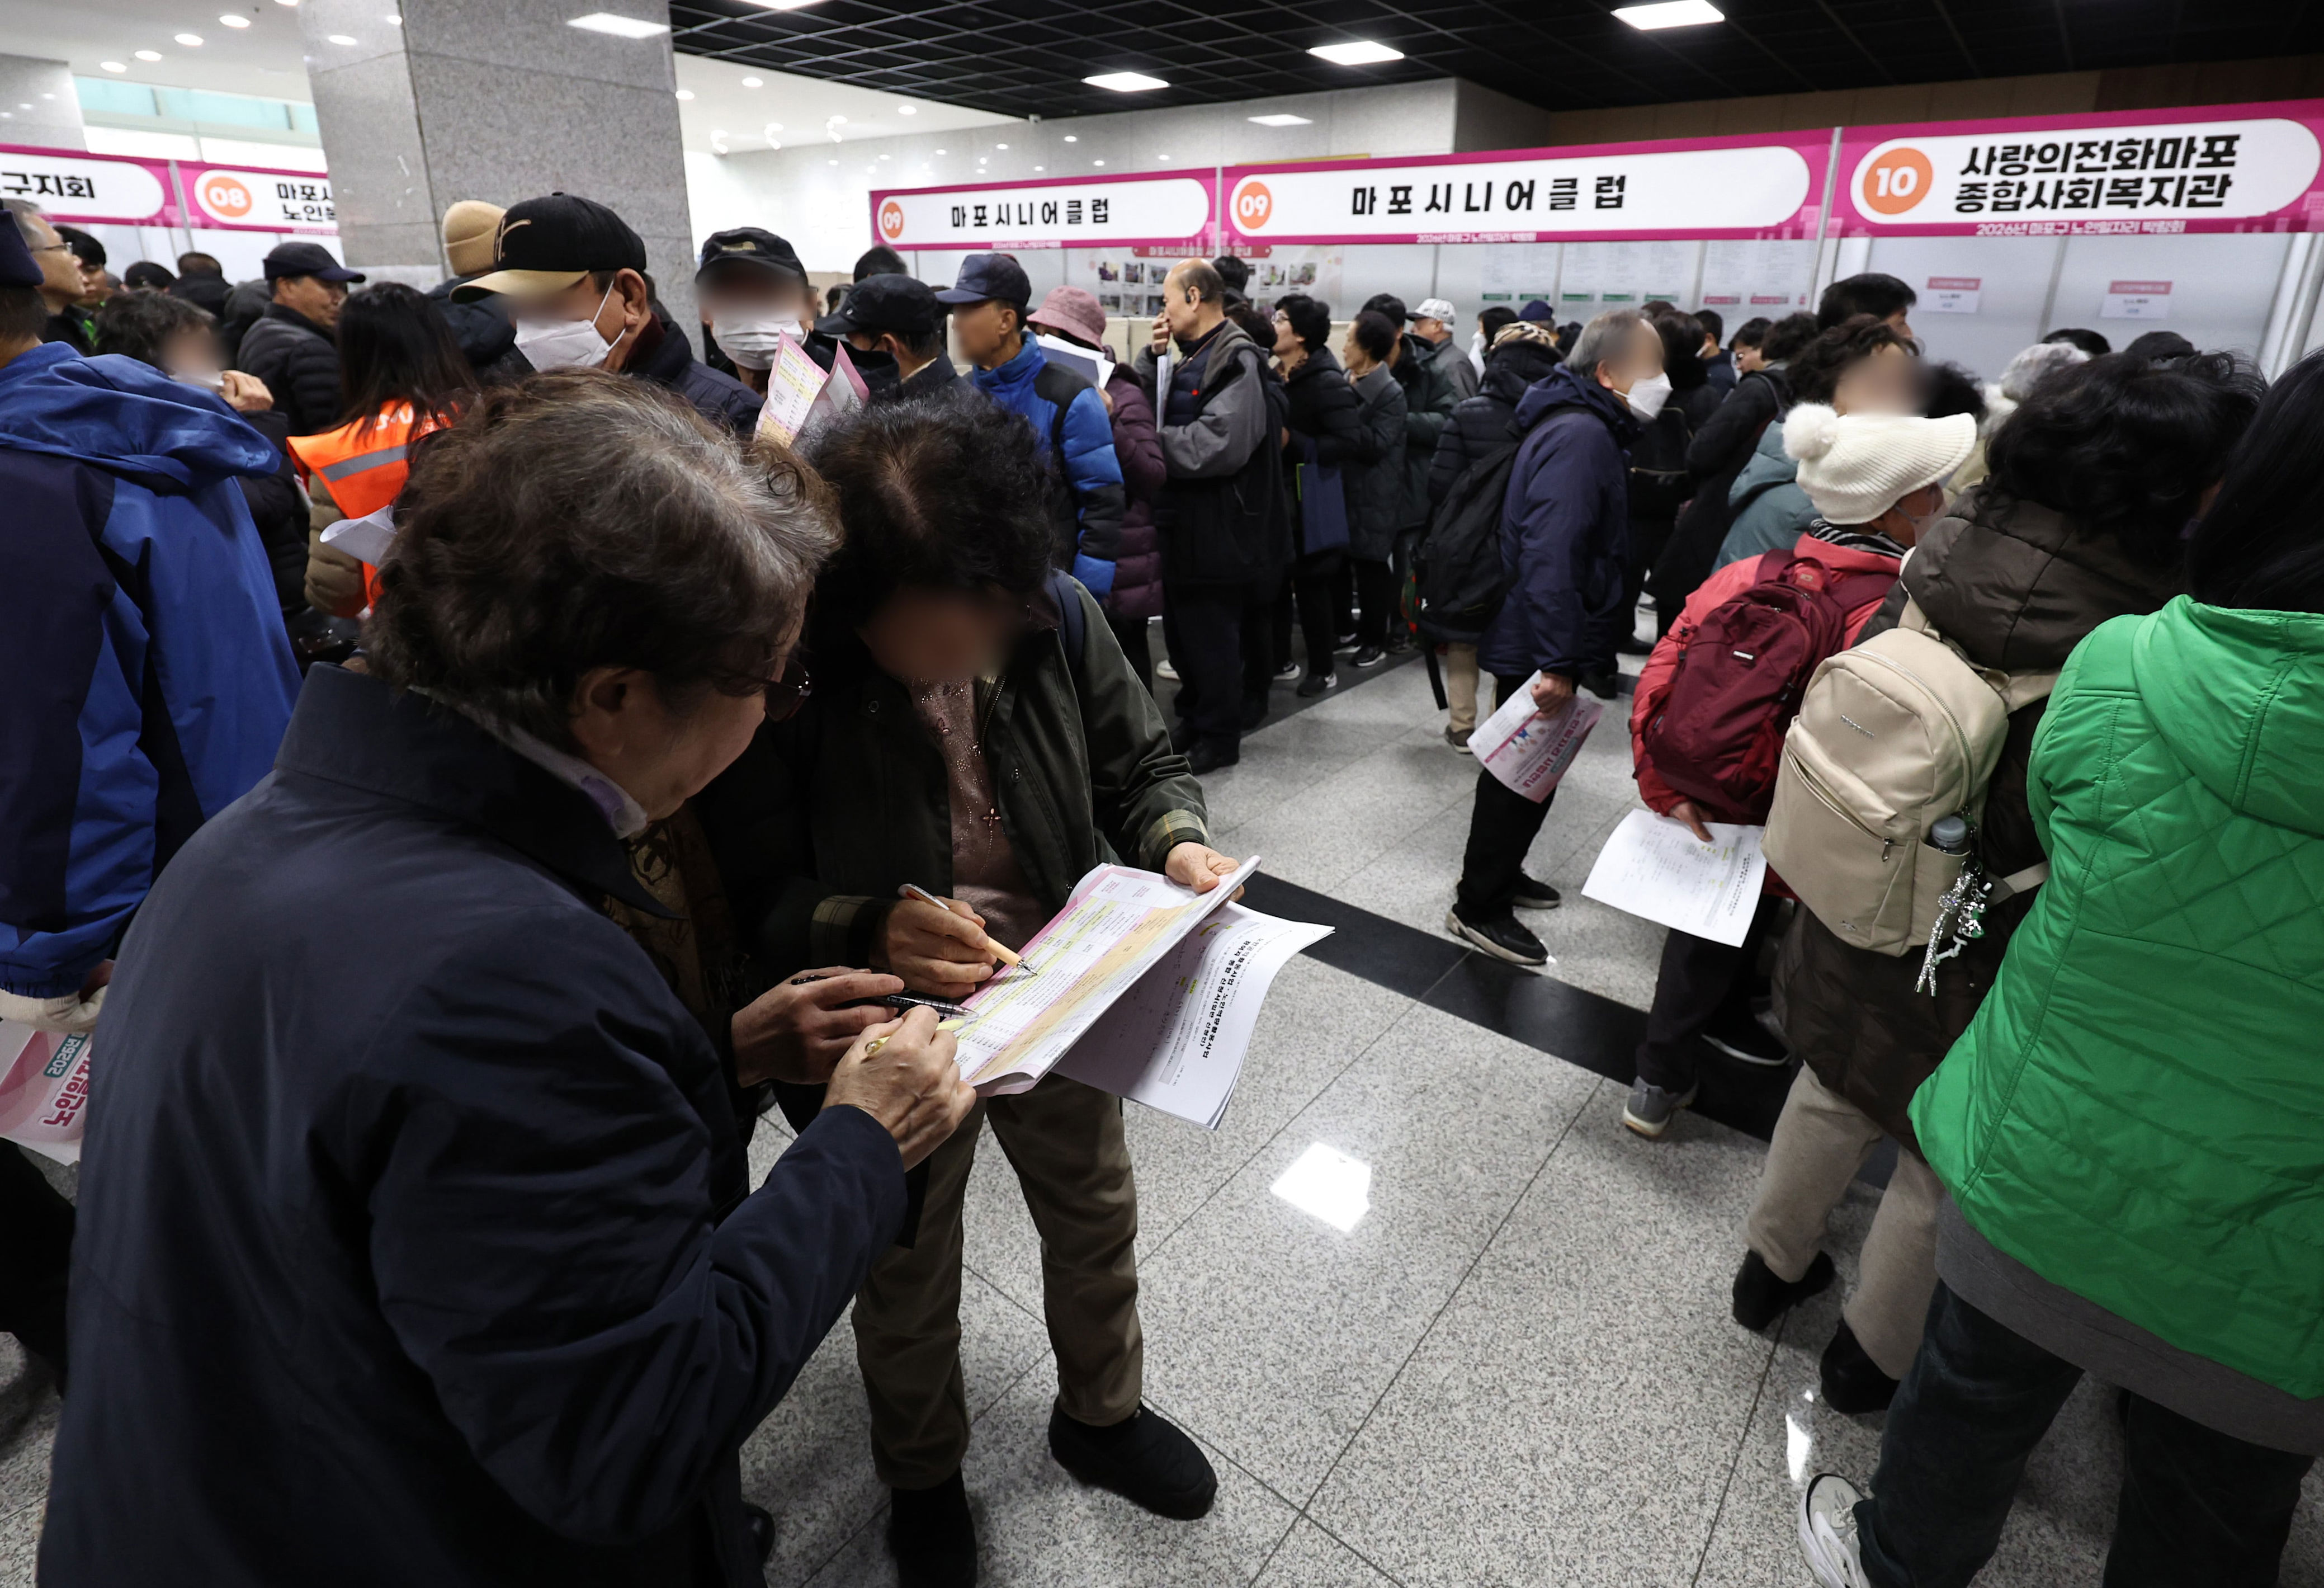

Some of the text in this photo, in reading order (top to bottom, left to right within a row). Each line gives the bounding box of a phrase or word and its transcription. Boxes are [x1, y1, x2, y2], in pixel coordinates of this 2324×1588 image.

[1961, 134, 2241, 176] 사랑의전화마포
[0, 172, 95, 199] 구지회
[1352, 175, 1627, 215] 마포시니어클럽
[1876, 166, 1918, 197] 10
[1955, 174, 2232, 213] 종합사회복지관
[208, 186, 248, 209] 08
[951, 198, 1109, 227] 마포시니어클럽
[1240, 195, 1268, 217] 09
[884, 211, 901, 229] 09
[1976, 223, 2028, 235] 2026년
[46, 1038, 82, 1076] 2026년
[42, 1052, 91, 1127] 노인일
